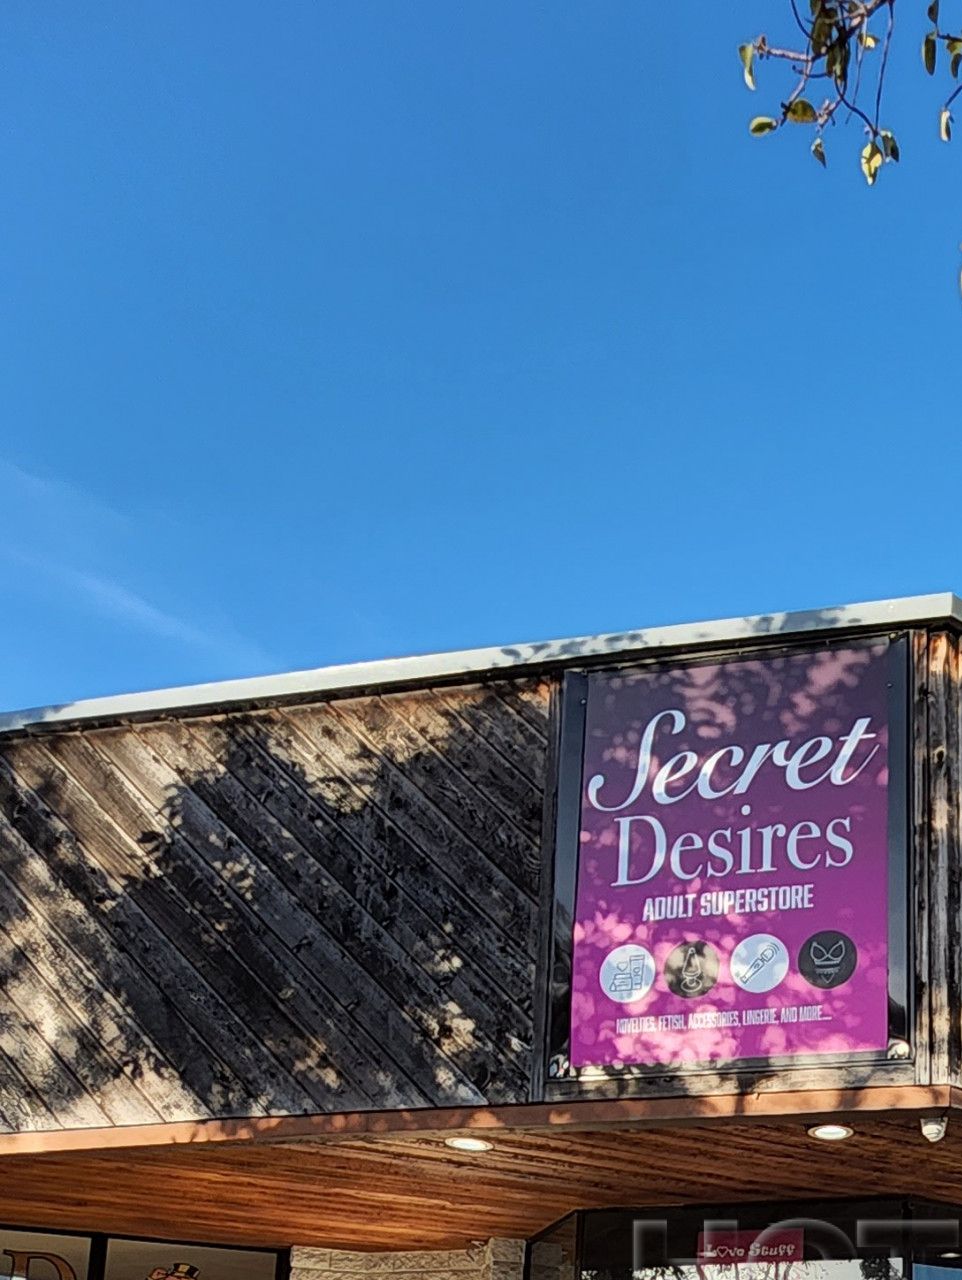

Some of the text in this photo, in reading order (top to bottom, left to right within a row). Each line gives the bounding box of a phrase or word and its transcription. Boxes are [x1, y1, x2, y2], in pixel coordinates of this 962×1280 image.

[588, 710, 880, 812] Secret
[610, 804, 854, 888] Desires
[642, 885, 815, 922] ADULT SUPERSTORE
